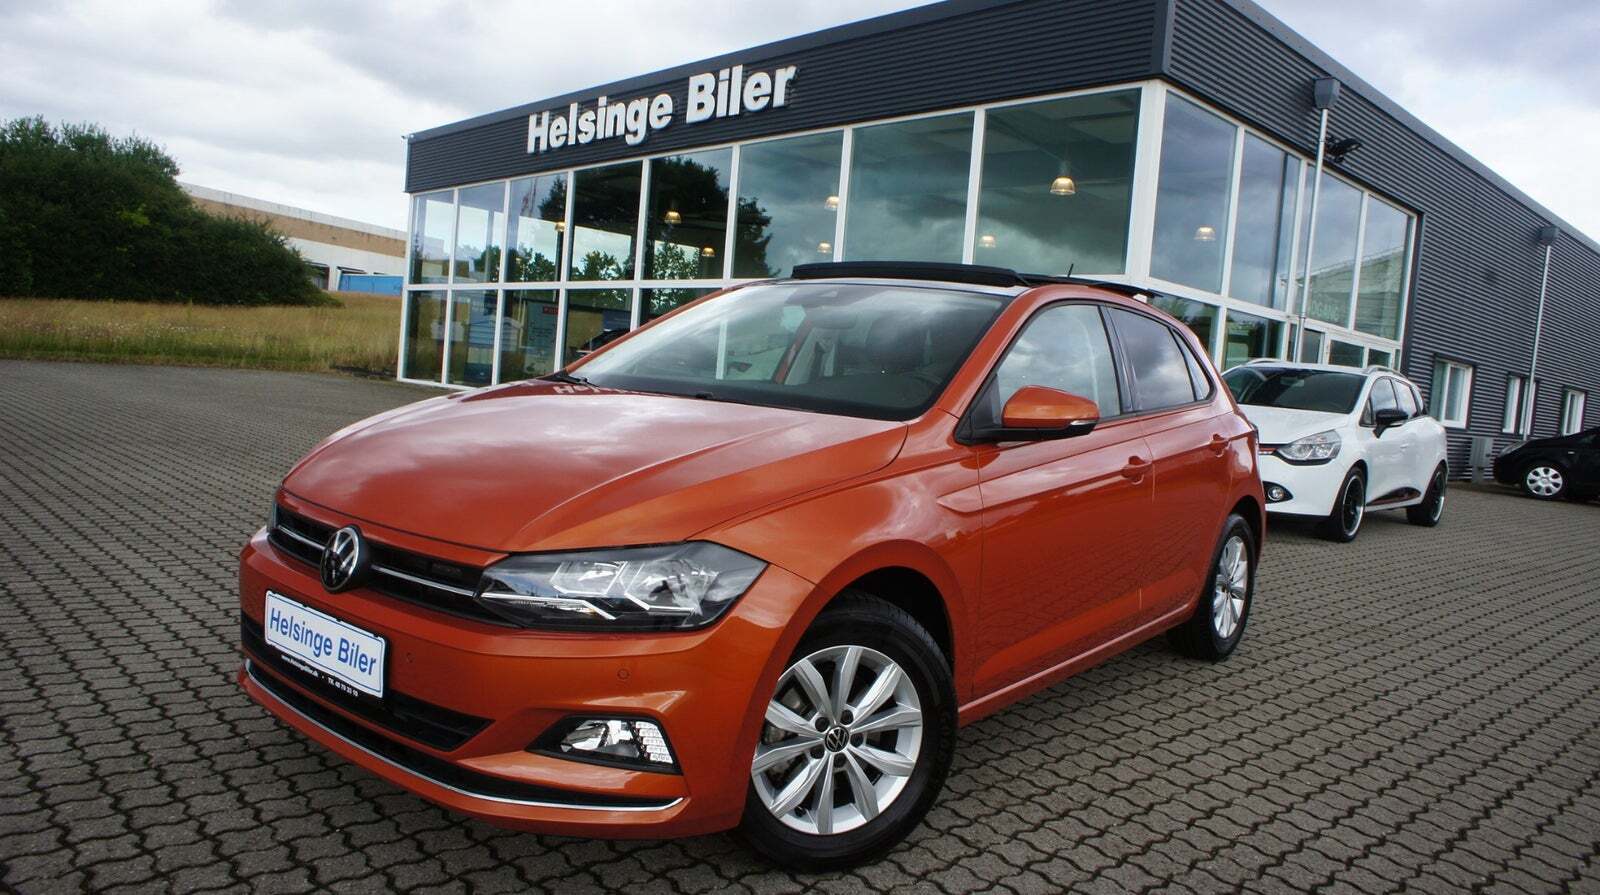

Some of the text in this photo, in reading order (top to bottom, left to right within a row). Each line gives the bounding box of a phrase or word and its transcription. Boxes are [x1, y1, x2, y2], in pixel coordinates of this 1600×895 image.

[527, 64, 797, 154] Helsinge Biler
[270, 607, 333, 658] Helsinge
[338, 637, 377, 676] Biler
